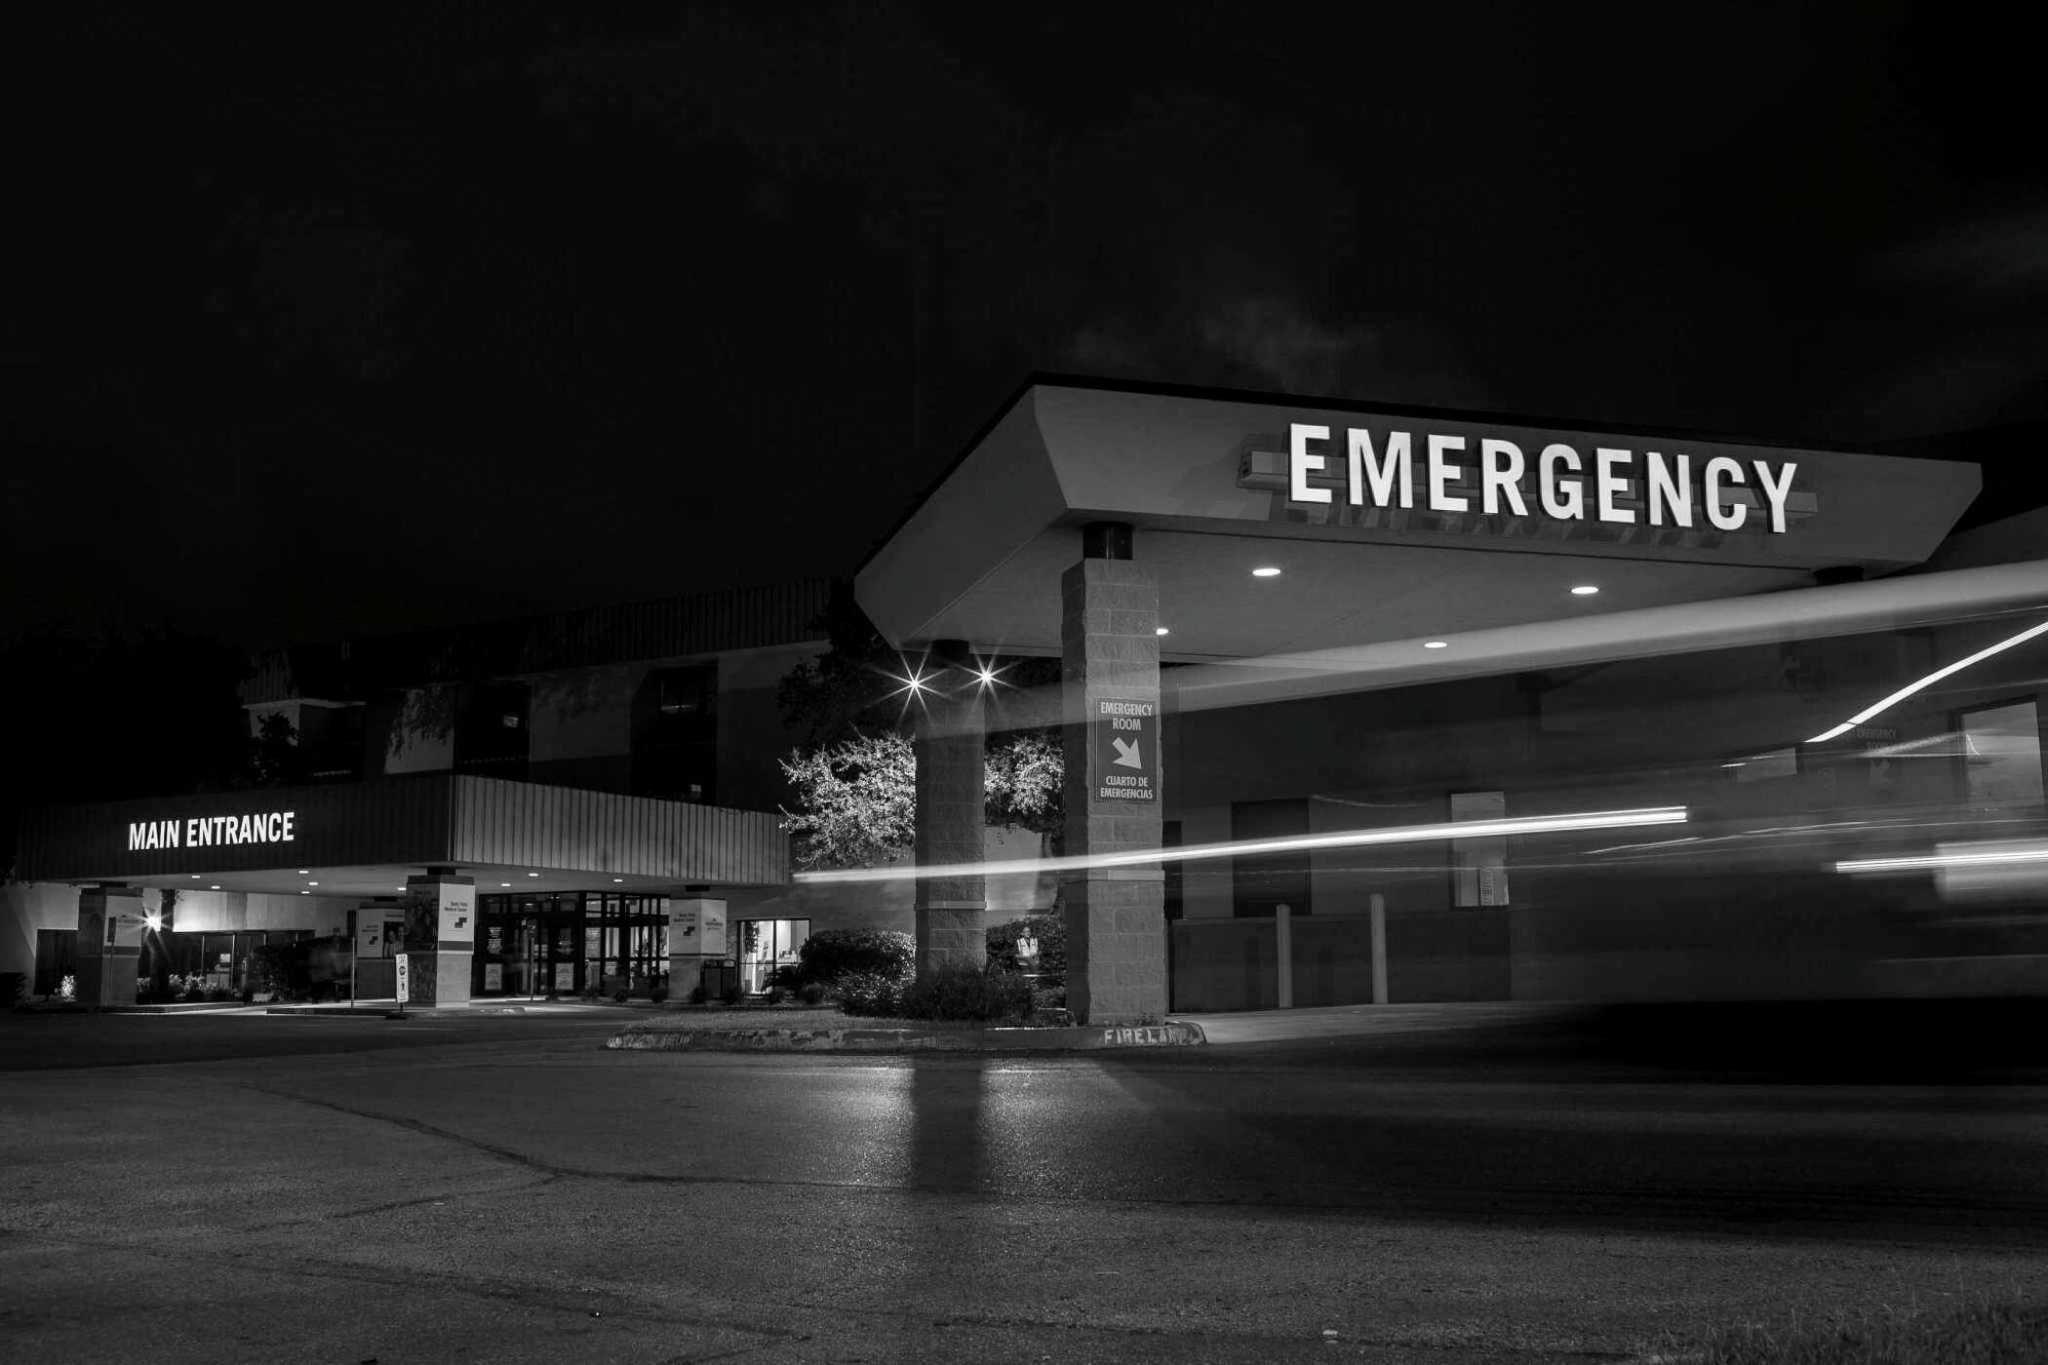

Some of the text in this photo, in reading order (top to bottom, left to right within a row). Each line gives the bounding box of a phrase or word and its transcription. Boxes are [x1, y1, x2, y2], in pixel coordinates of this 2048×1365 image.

[1290, 423, 1798, 534] EMERGENCY
[1101, 702, 1153, 716] EMERGENCY
[1112, 718, 1141, 731] ROOM
[1105, 776, 1149, 787] CUARTO DE
[1100, 788, 1153, 799] EMERGENCIAS
[128, 811, 295, 851] MAIN ENTRANCE
